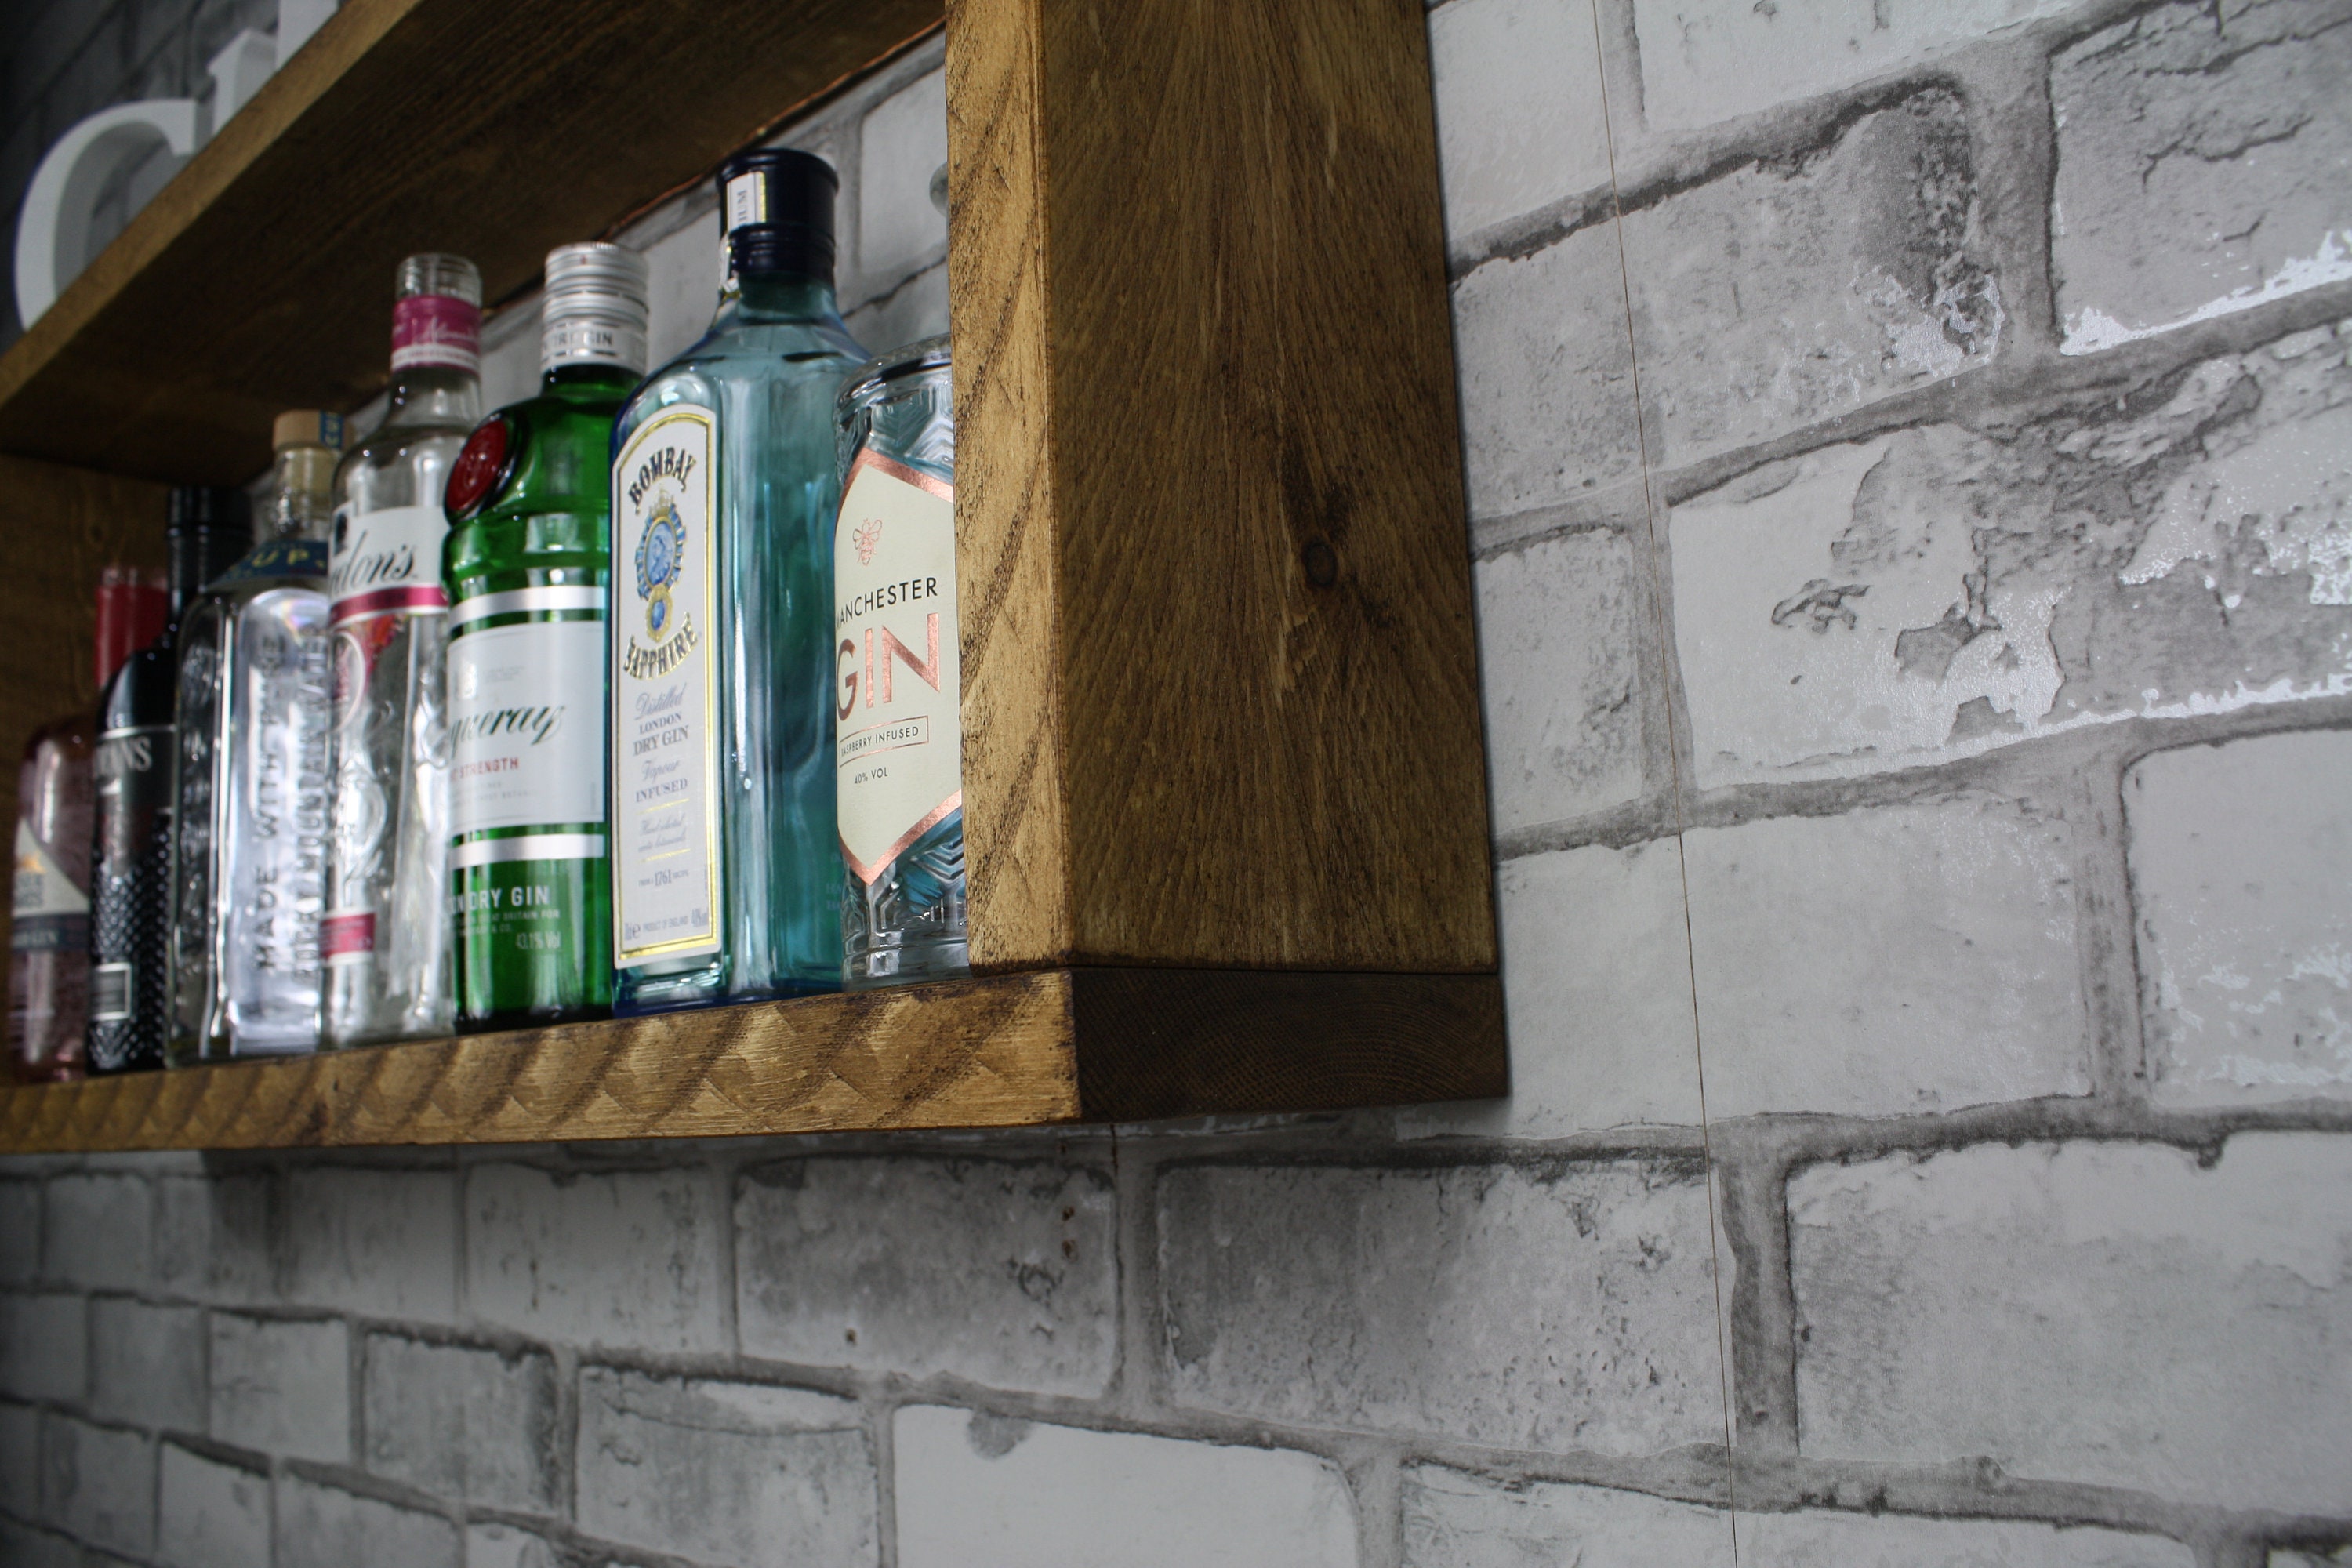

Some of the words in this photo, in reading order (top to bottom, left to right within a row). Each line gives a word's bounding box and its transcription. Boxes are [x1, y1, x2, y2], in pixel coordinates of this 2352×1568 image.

[627, 446, 696, 514] BOMBAY
[623, 612, 698, 680] SAPPHIRE
[837, 613, 941, 721] GIN
[633, 681, 687, 720] Distilled
[639, 713, 682, 735] LONDON
[633, 734, 660, 756] DRY
[662, 724, 690, 746] GIN
[841, 736, 872, 757] RASPBERRY
[875, 726, 920, 744] INFUSED
[459, 757, 519, 779] STRENGTH
[854, 772, 869, 785] 40%
[870, 767, 889, 779] VOL
[636, 778, 688, 803] INFUSED
[654, 869, 672, 887] 1761
[468, 887, 502, 911] DRY
[510, 884, 550, 907] GIN
